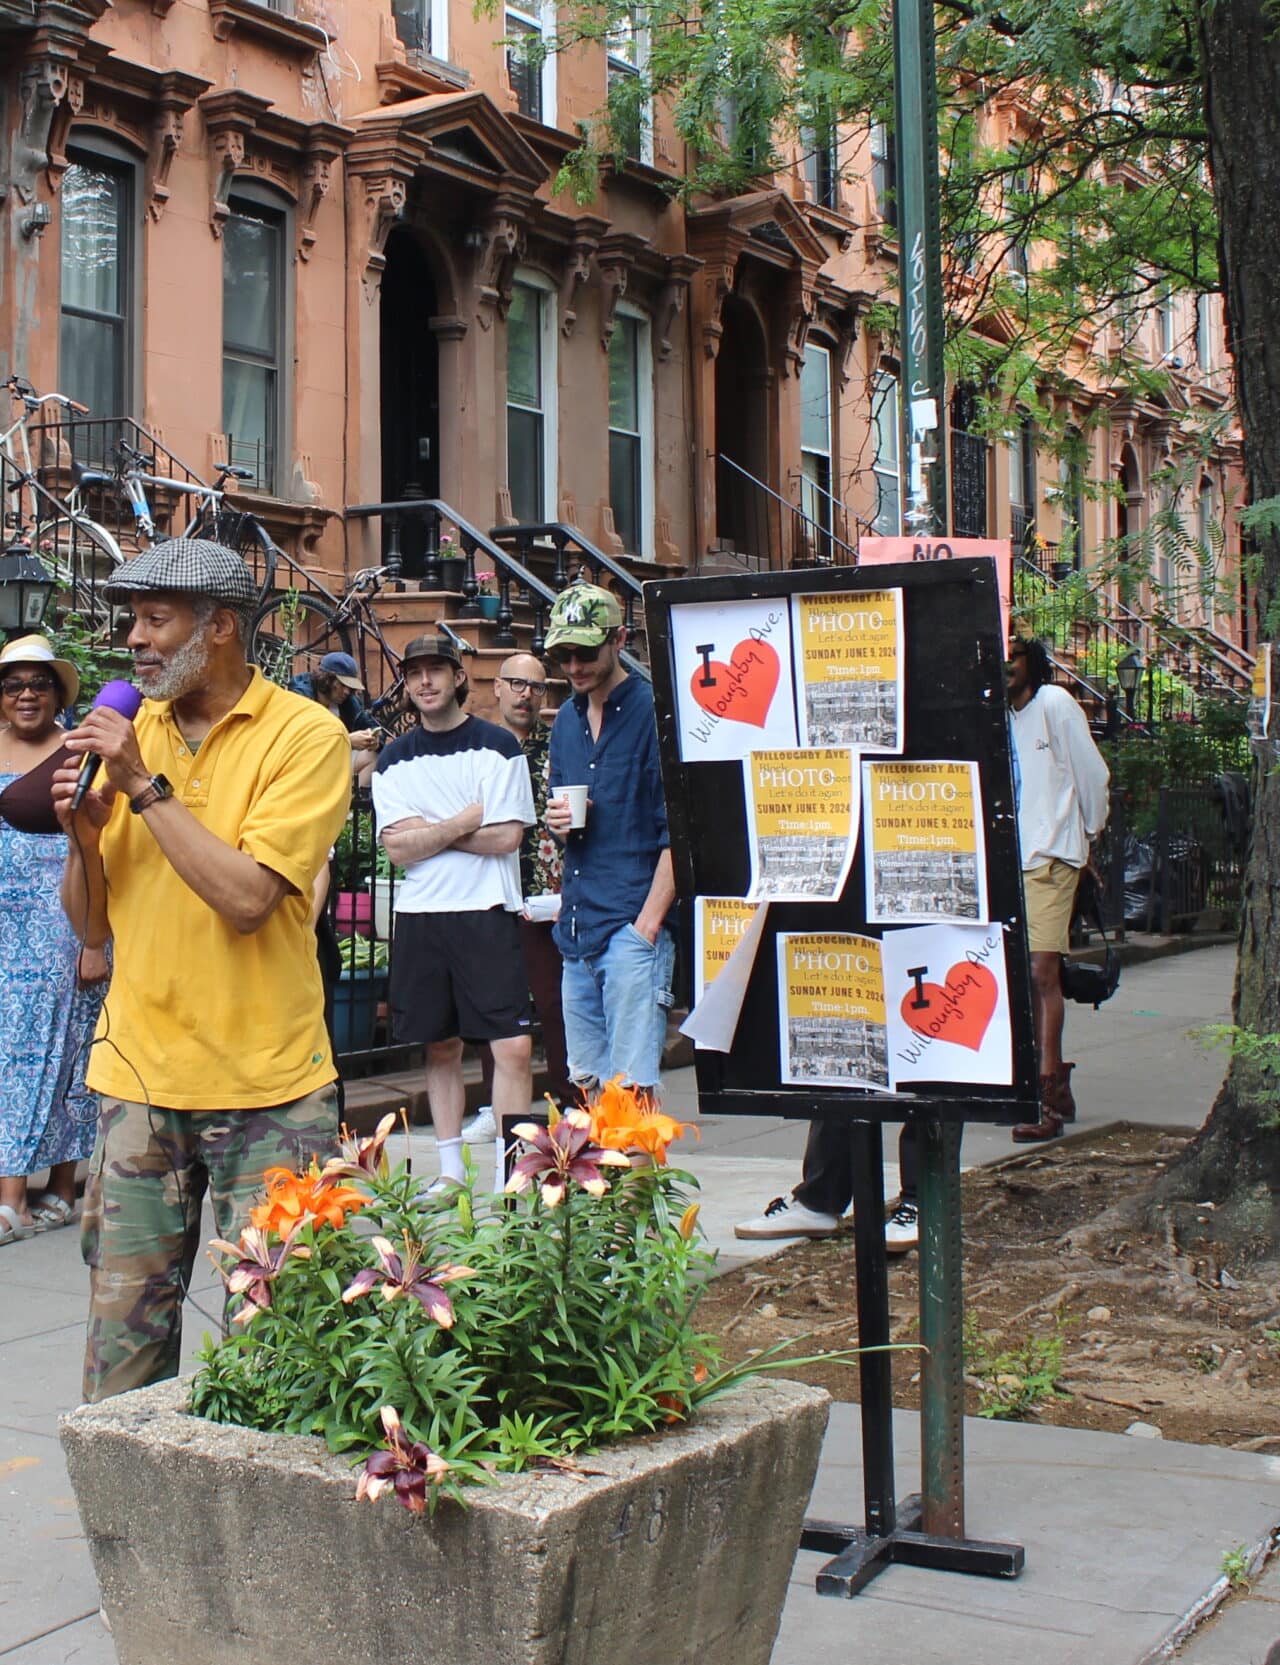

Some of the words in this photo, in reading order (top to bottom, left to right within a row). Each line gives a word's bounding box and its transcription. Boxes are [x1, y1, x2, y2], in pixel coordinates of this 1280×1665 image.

[913, 543, 953, 561] NO
[808, 611, 883, 633] PHOTO
[805, 648, 841, 660] SUNDAY
[845, 647, 867, 658] JUNE
[878, 646, 897, 657] 2024
[695, 643, 717, 688] I
[689, 651, 764, 743] Willoughby
[749, 611, 783, 646] Ave.
[825, 749, 849, 760] AVE.
[759, 768, 835, 788] PHOTO
[879, 782, 956, 801] PHOTO
[757, 803, 792, 814] SUNDAY
[796, 803, 817, 813] JUNE
[830, 803, 851, 813] 2024
[875, 818, 912, 829] SUNDAY
[916, 818, 938, 828] JUNE
[953, 818, 975, 829] 2024
[793, 952, 869, 973] PHOTO
[790, 985, 827, 996] SUNDAY
[831, 986, 853, 998] JUNE
[866, 990, 884, 1003] 2024
[907, 966, 930, 1010] I
[896, 974, 982, 1064] Willoughby
[965, 936, 1001, 970] Ave.
